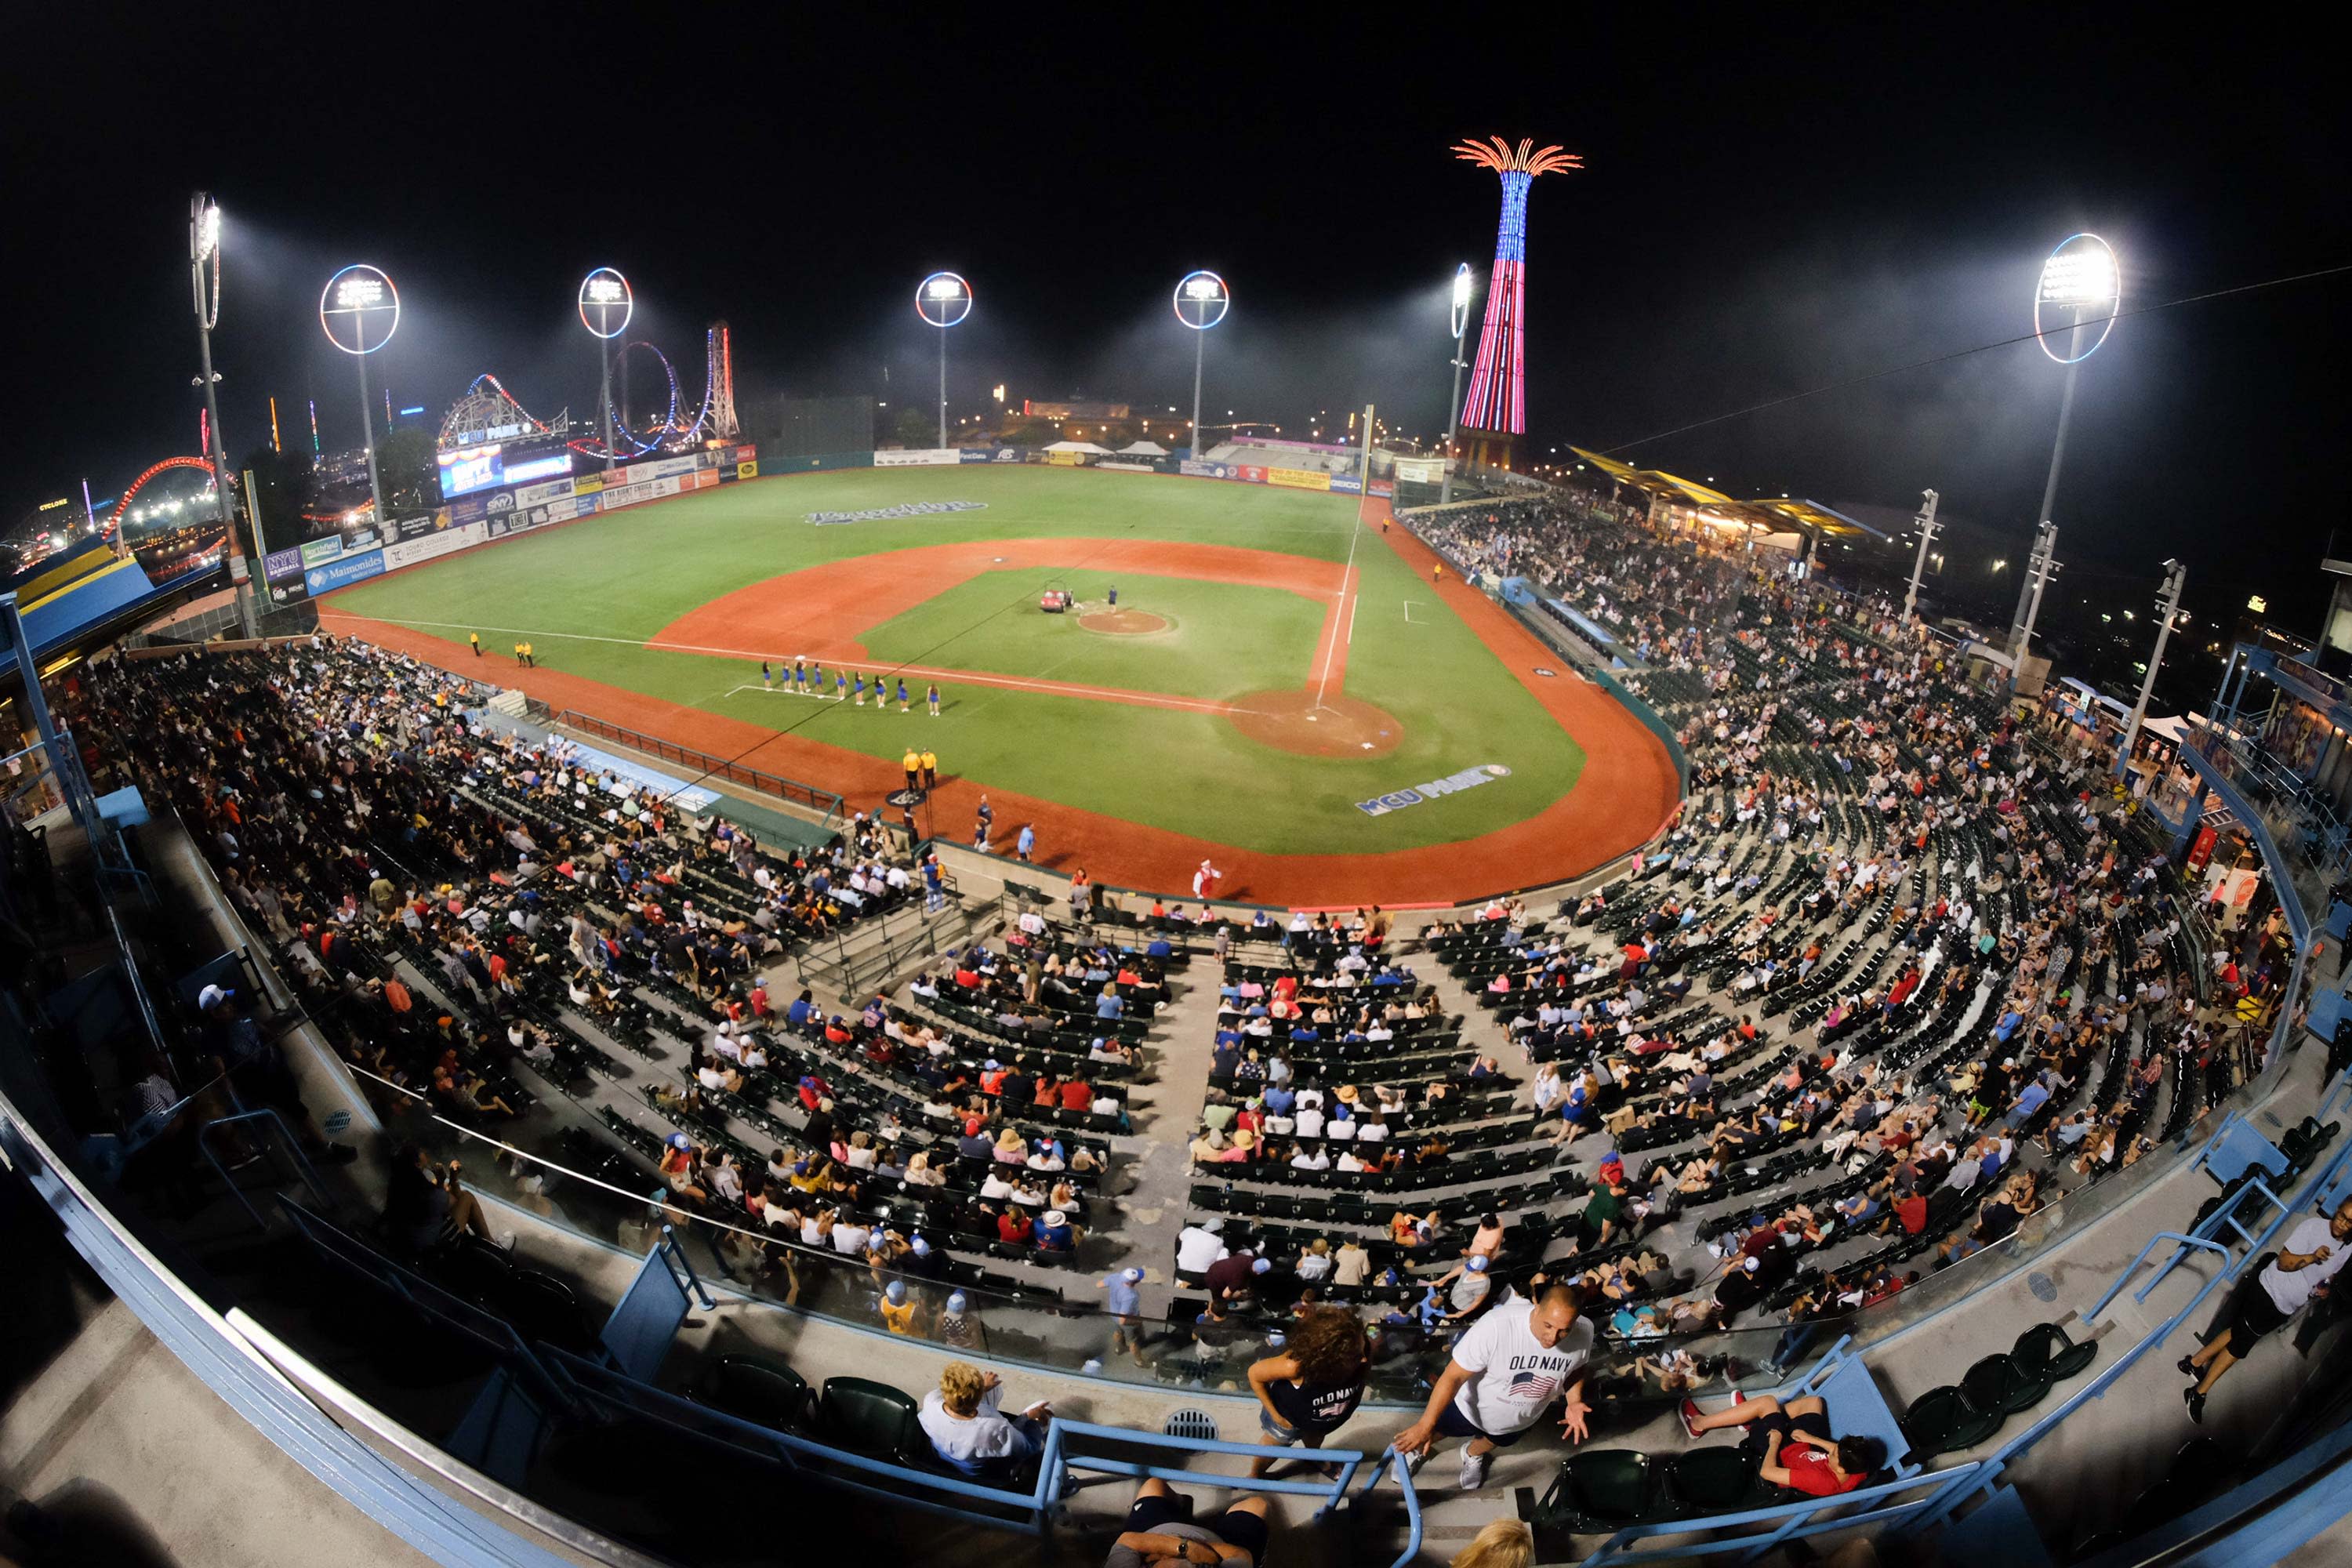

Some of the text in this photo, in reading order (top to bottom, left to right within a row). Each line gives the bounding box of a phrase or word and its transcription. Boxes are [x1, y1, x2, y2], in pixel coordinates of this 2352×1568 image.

[458, 430, 485, 445] MCU
[39, 498, 68, 511] CYCLONE
[487, 496, 509, 510] SNY
[267, 550, 299, 570] NYU
[329, 556, 383, 579] Maimonides
[270, 563, 300, 575] BASEBALL
[1355, 788, 1423, 816] MCU
[1509, 1356, 1573, 1372] OLD NAVY
[1312, 1392, 1334, 1406] OLD
